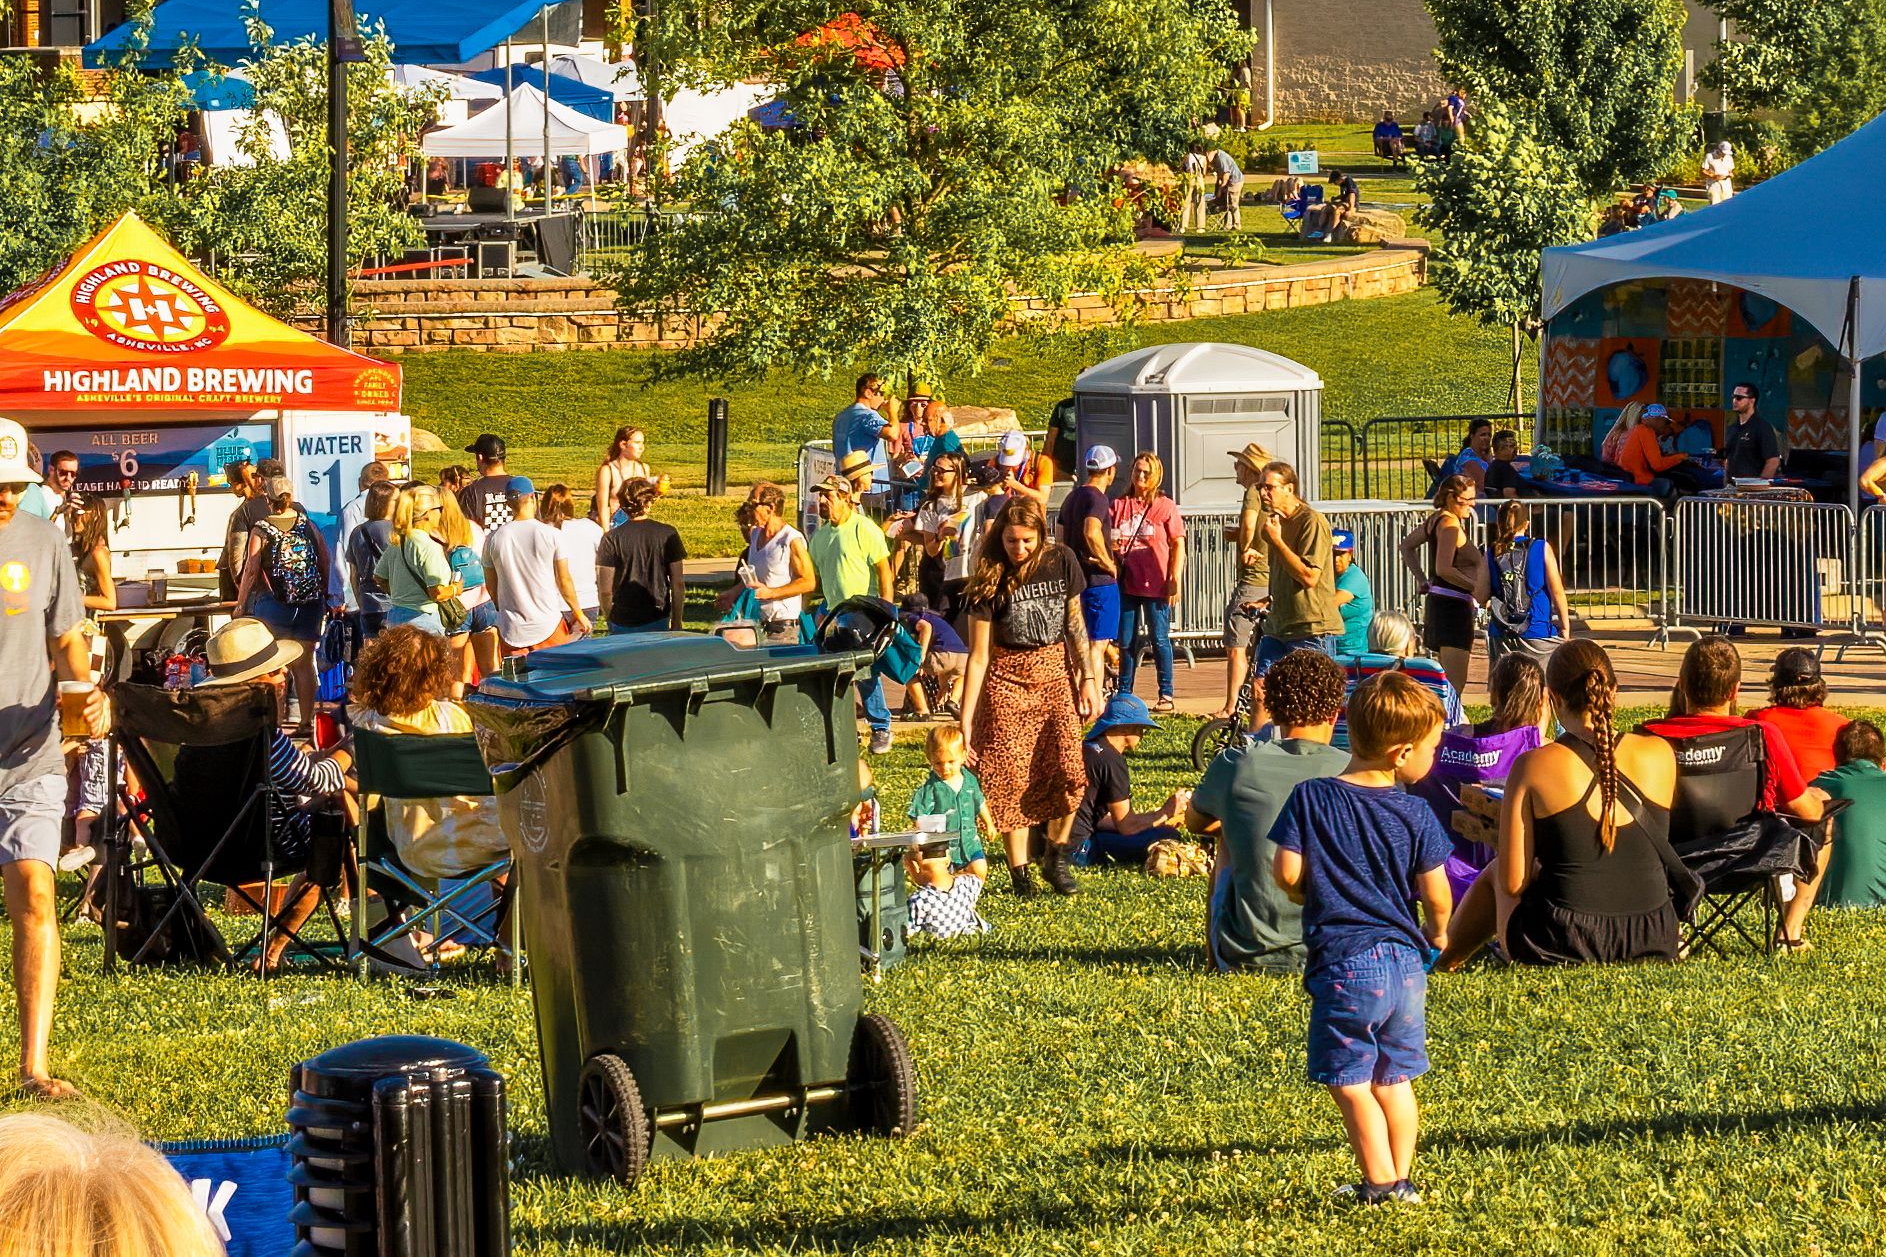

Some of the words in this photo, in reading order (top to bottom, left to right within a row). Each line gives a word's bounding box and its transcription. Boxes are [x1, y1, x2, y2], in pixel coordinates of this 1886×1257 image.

[75, 262, 141, 304] HIGHLAND
[147, 265, 220, 314] BREWING
[43, 367, 181, 392] HIGHLAND
[187, 368, 314, 394] BREWING
[76, 393, 142, 403] ASHEVILLE'S
[145, 393, 195, 403] ORIGINAL
[198, 394, 232, 404] CRAFT
[235, 394, 283, 404] BREWERY
[91, 433, 115, 446] ALL
[121, 431, 159, 445] BEER
[297, 435, 363, 456] WATER
[138, 480, 150, 490] ID
[1441, 746, 1503, 763] Academy
[1676, 745, 1727, 762] ademy
